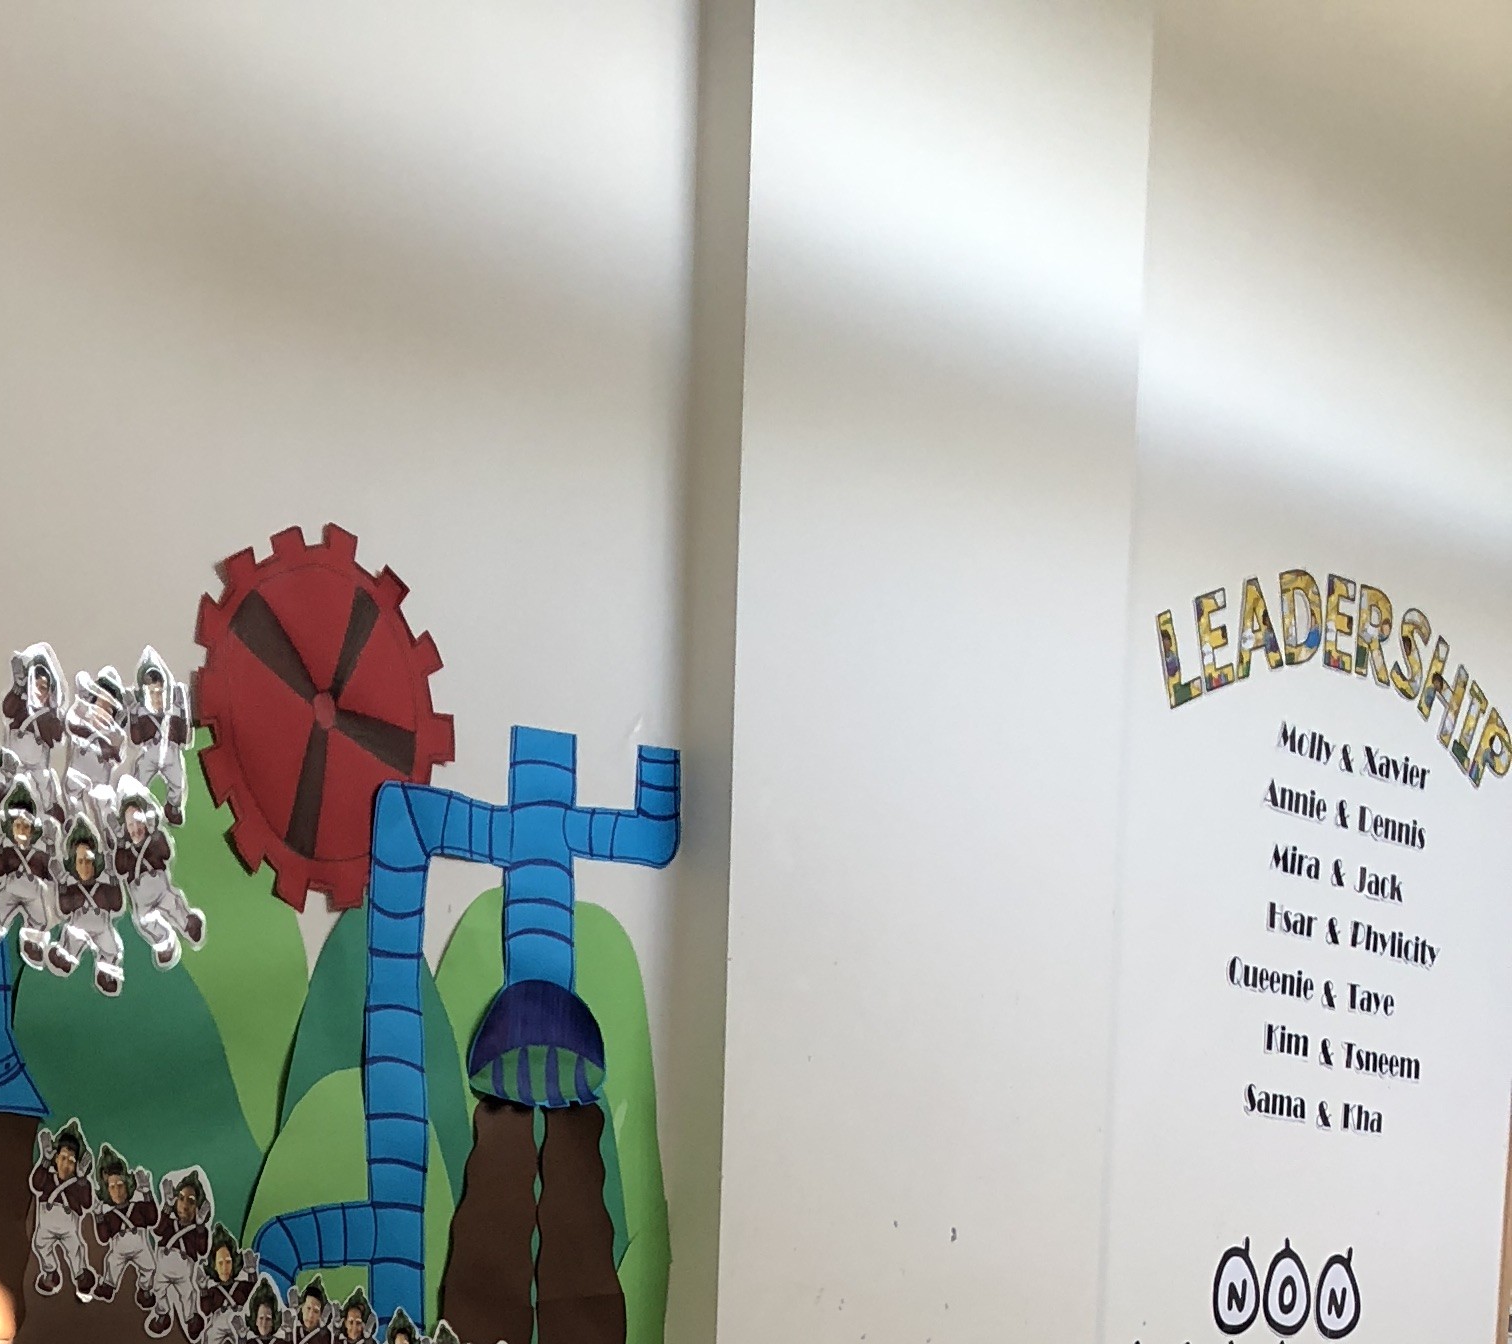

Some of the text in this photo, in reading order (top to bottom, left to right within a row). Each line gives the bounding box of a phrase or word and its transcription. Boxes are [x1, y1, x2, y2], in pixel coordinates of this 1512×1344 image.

[1155, 569, 1511, 788] LEADERSHIP
[1277, 721, 1430, 790] Molly & Xavier
[1263, 779, 1426, 849] Annie & Dennis
[1270, 844, 1403, 902] Mira & Jack
[1267, 901, 1440, 967] Hsar & Phylicity
[1228, 956, 1394, 1016] Queenie & Taye
[1265, 1023, 1420, 1079] Kim & Tsneem
[1244, 1083, 1383, 1133] Sama & Kha
